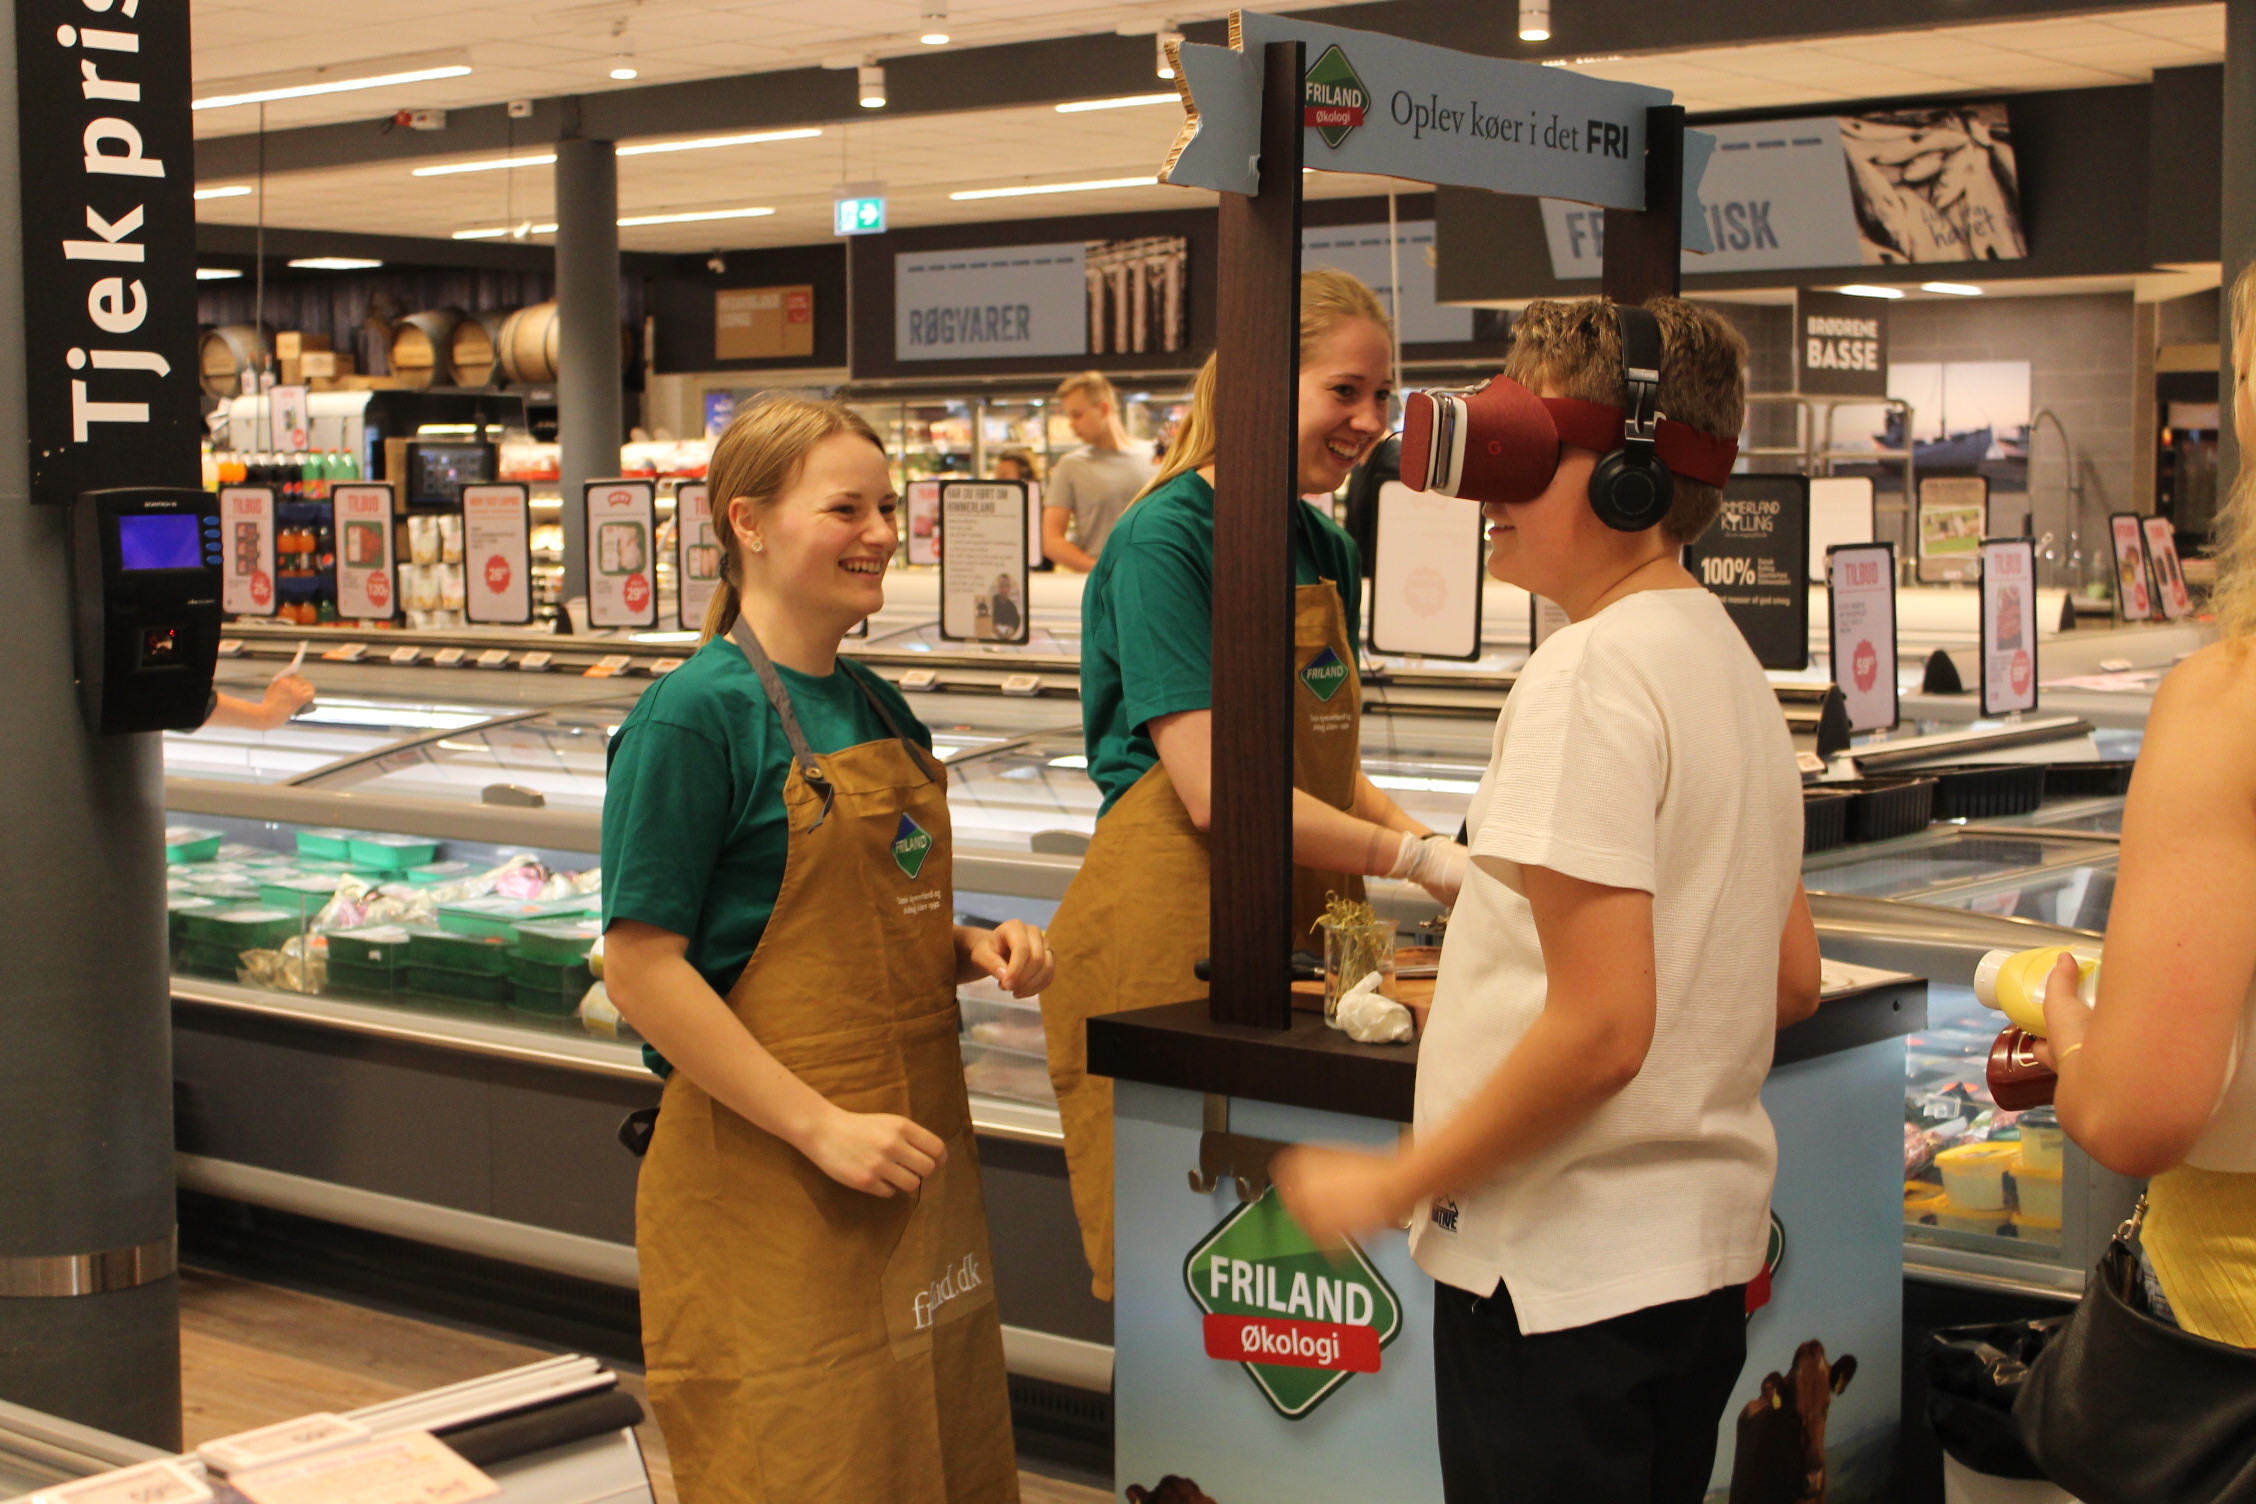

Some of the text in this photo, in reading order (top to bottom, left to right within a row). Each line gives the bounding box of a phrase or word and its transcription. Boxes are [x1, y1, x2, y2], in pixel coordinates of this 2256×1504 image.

[1305, 82, 1362, 108] FRILAND
[1315, 110, 1351, 125] Økologi
[1391, 90, 1629, 159] Oplev køer i det FRI
[1702, 201, 1779, 252] ISK
[62, 203, 171, 443] Tjek
[908, 303, 1031, 346] RØGVARER
[1807, 337, 1879, 371] BASSE
[1701, 557, 1756, 585] 100%
[1844, 562, 1879, 587] TILBUD
[1306, 666, 1344, 680] FRILAND
[895, 834, 927, 855] FRILAND
[1210, 1254, 1374, 1327] FRILAND
[1240, 1324, 1340, 1365] Økologi
